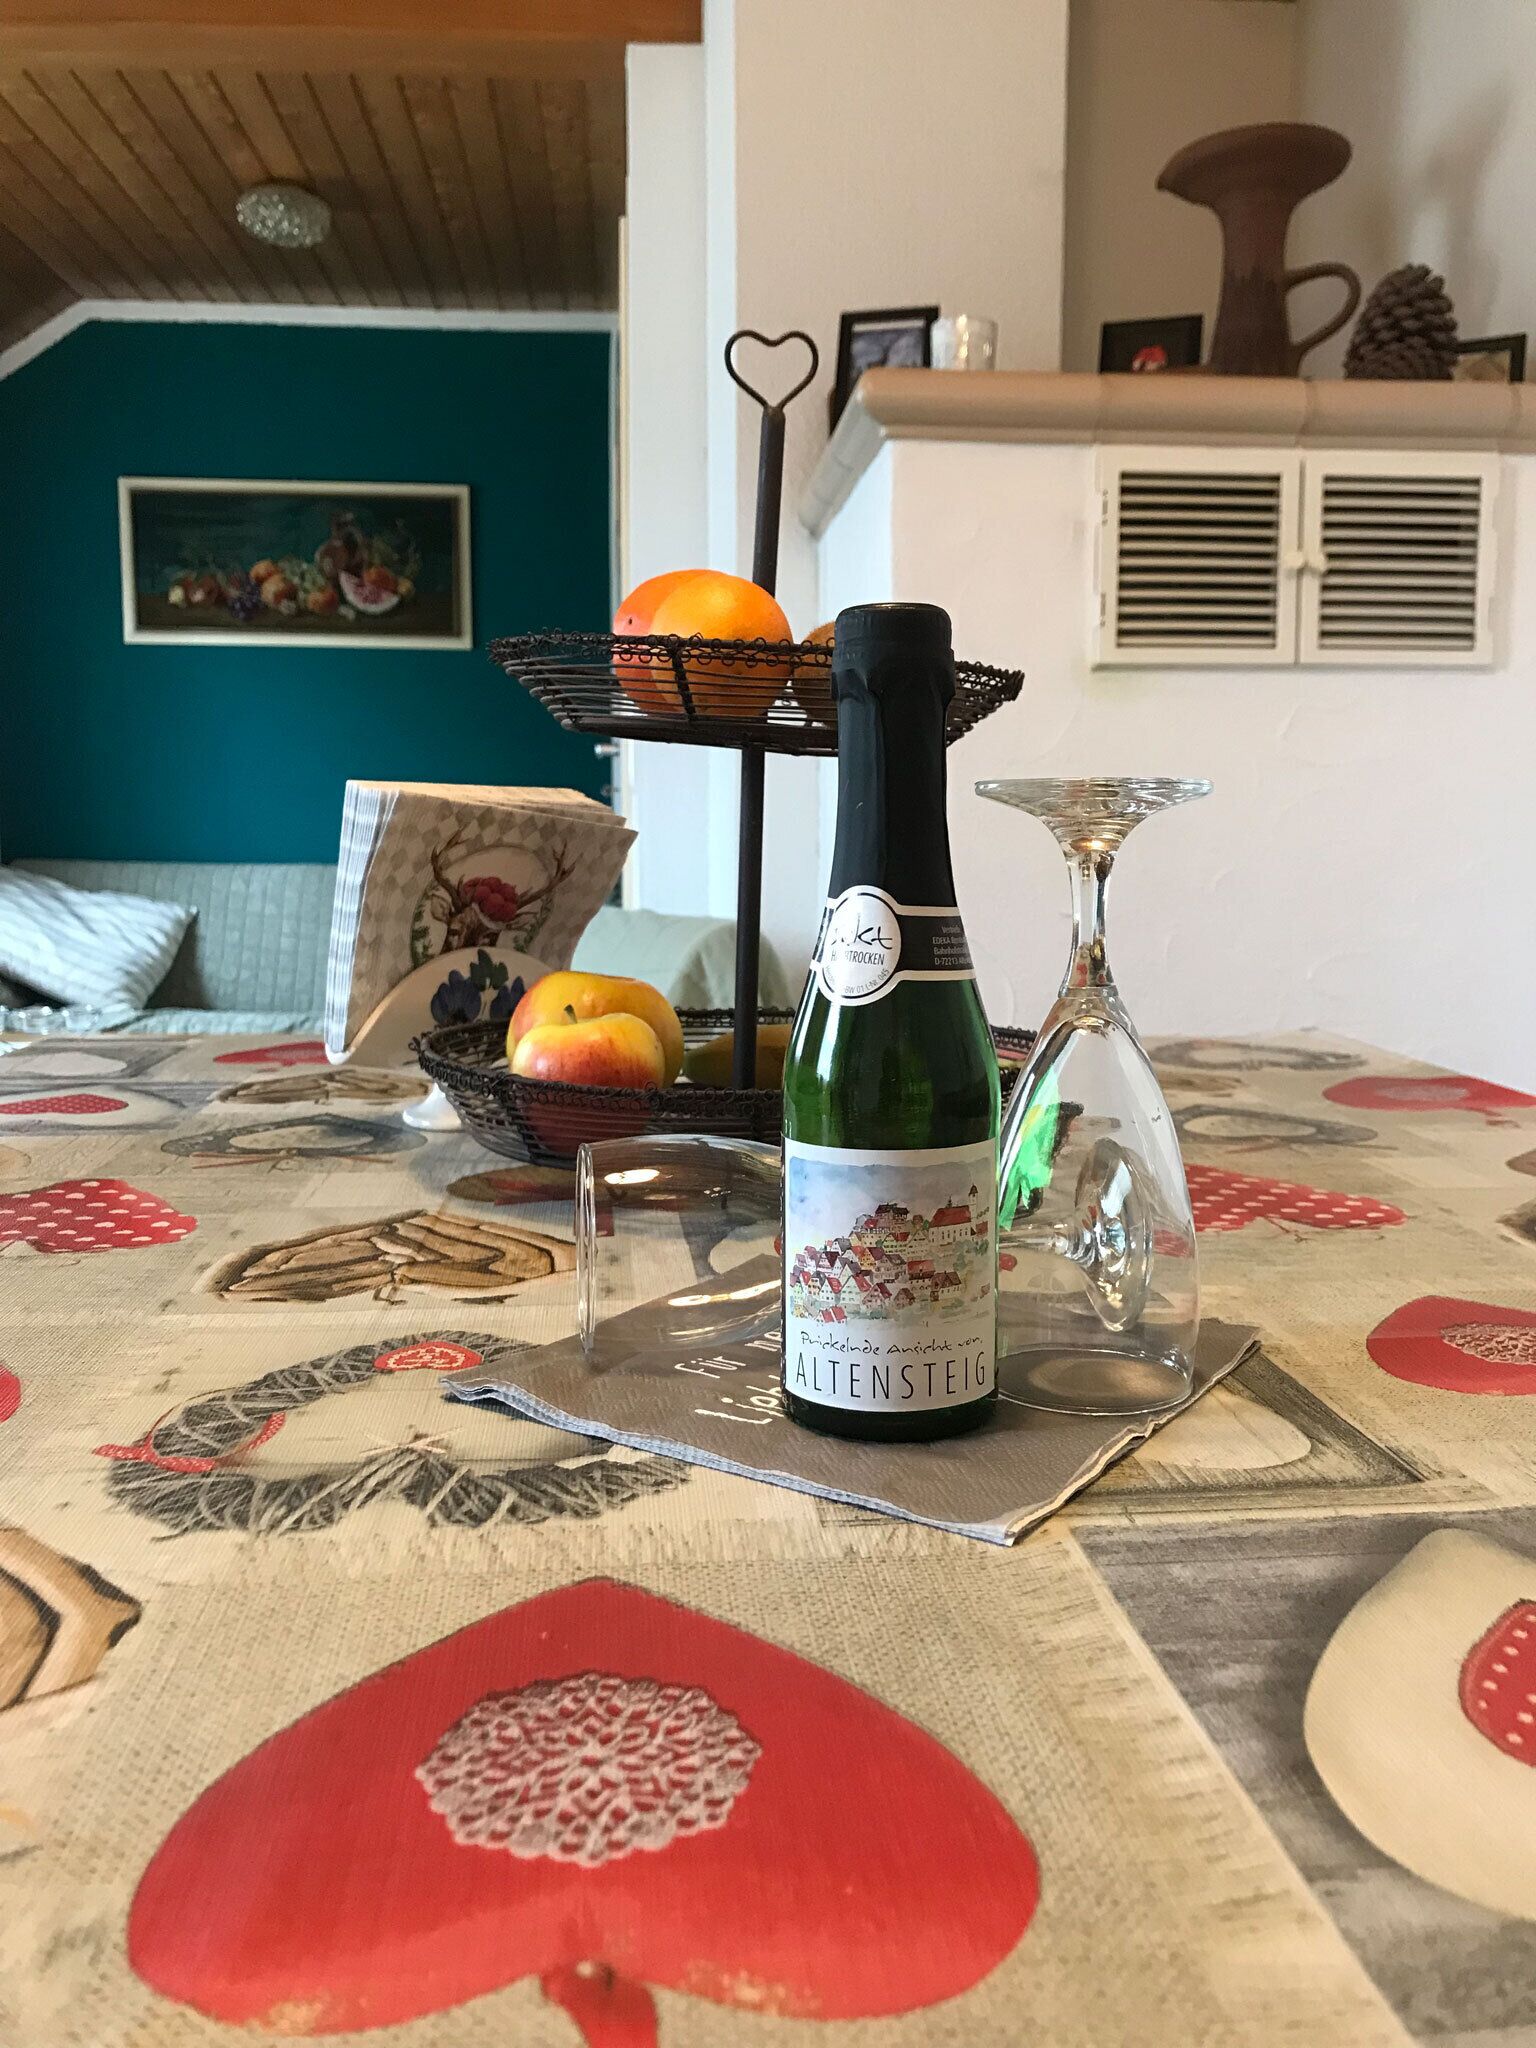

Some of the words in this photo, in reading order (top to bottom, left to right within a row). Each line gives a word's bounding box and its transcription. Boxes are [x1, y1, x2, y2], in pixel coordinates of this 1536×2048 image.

[830, 950, 885, 966] HBTROCKEN
[800, 1330, 880, 1356] Prickelnde
[957, 1335, 984, 1347] von
[795, 1351, 986, 1401] ALTENSTEIG
[694, 1374, 786, 1426] Lieb
